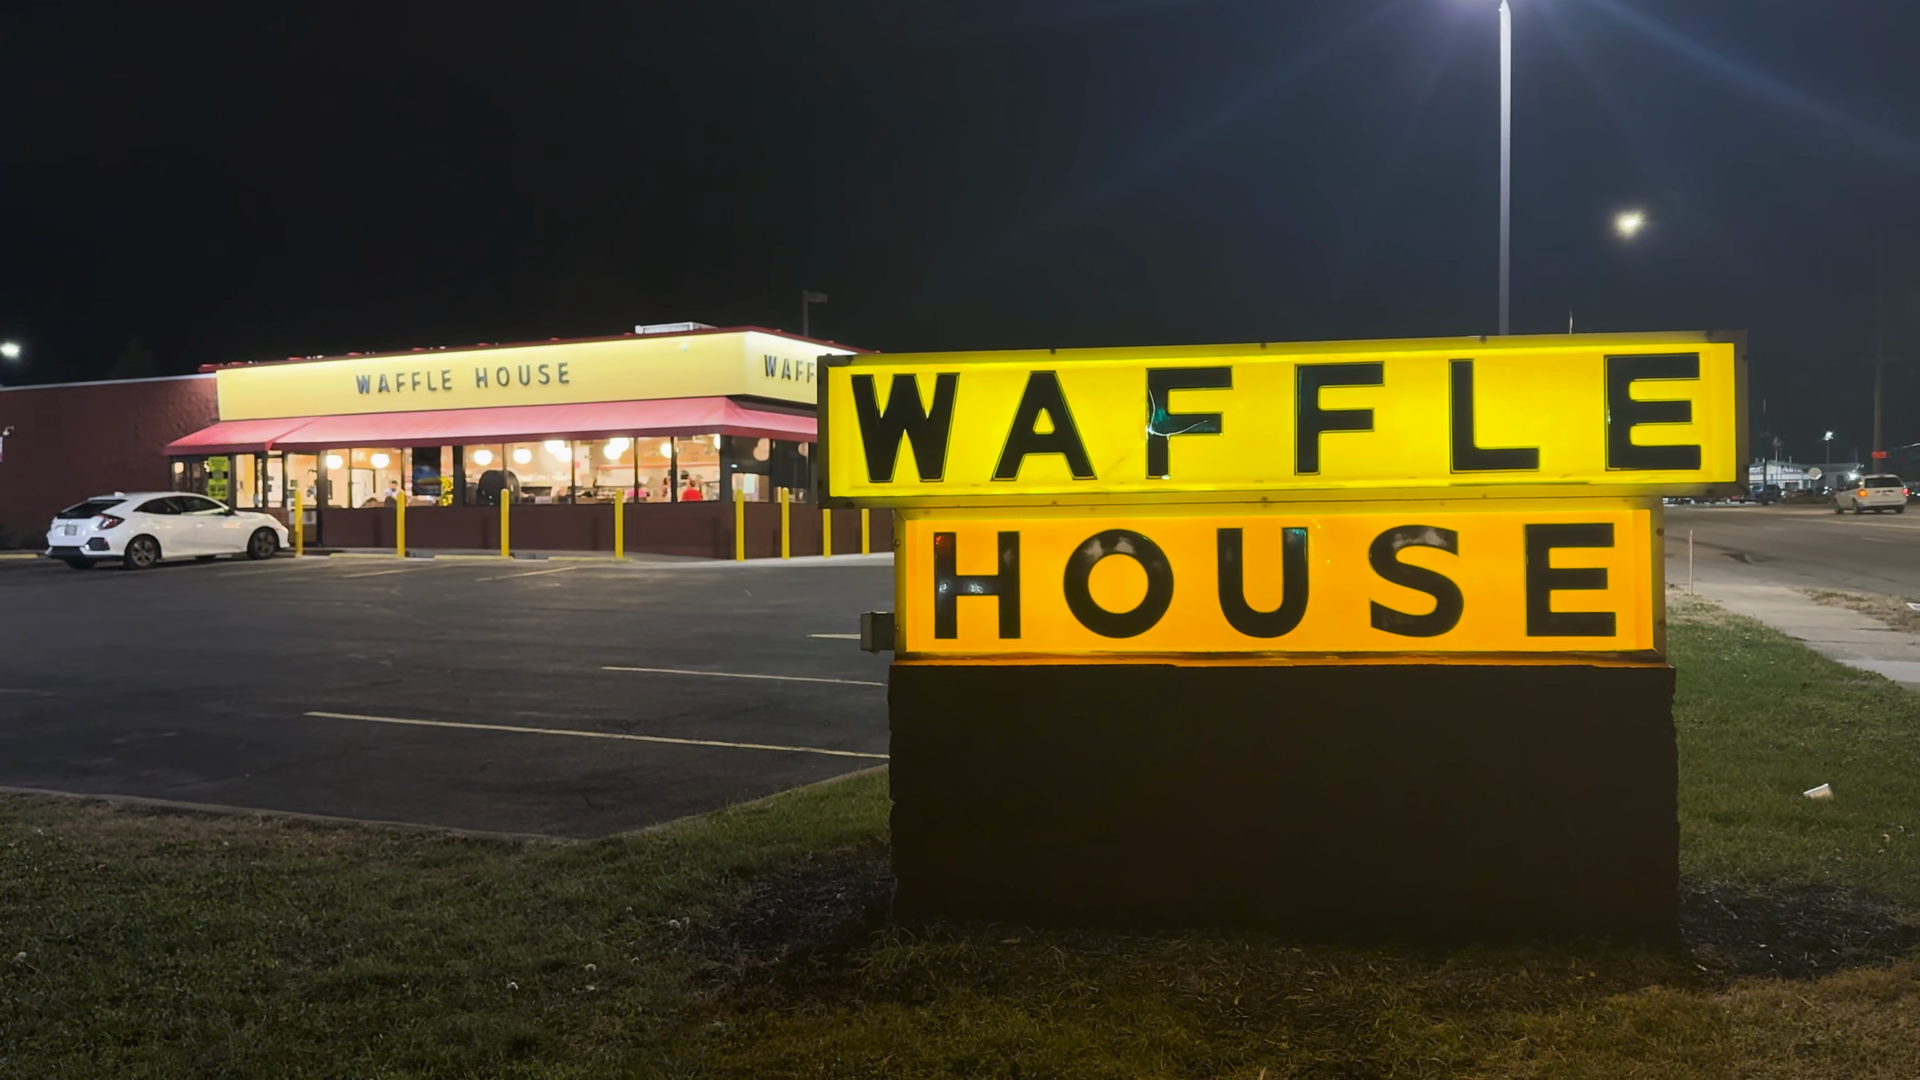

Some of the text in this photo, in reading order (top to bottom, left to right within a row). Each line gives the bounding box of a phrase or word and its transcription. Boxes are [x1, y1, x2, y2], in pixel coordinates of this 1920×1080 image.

[355, 362, 570, 395] WAFFLE HOUSE
[852, 353, 1701, 482] WAFFLE
[933, 523, 1617, 640] HOUSE
